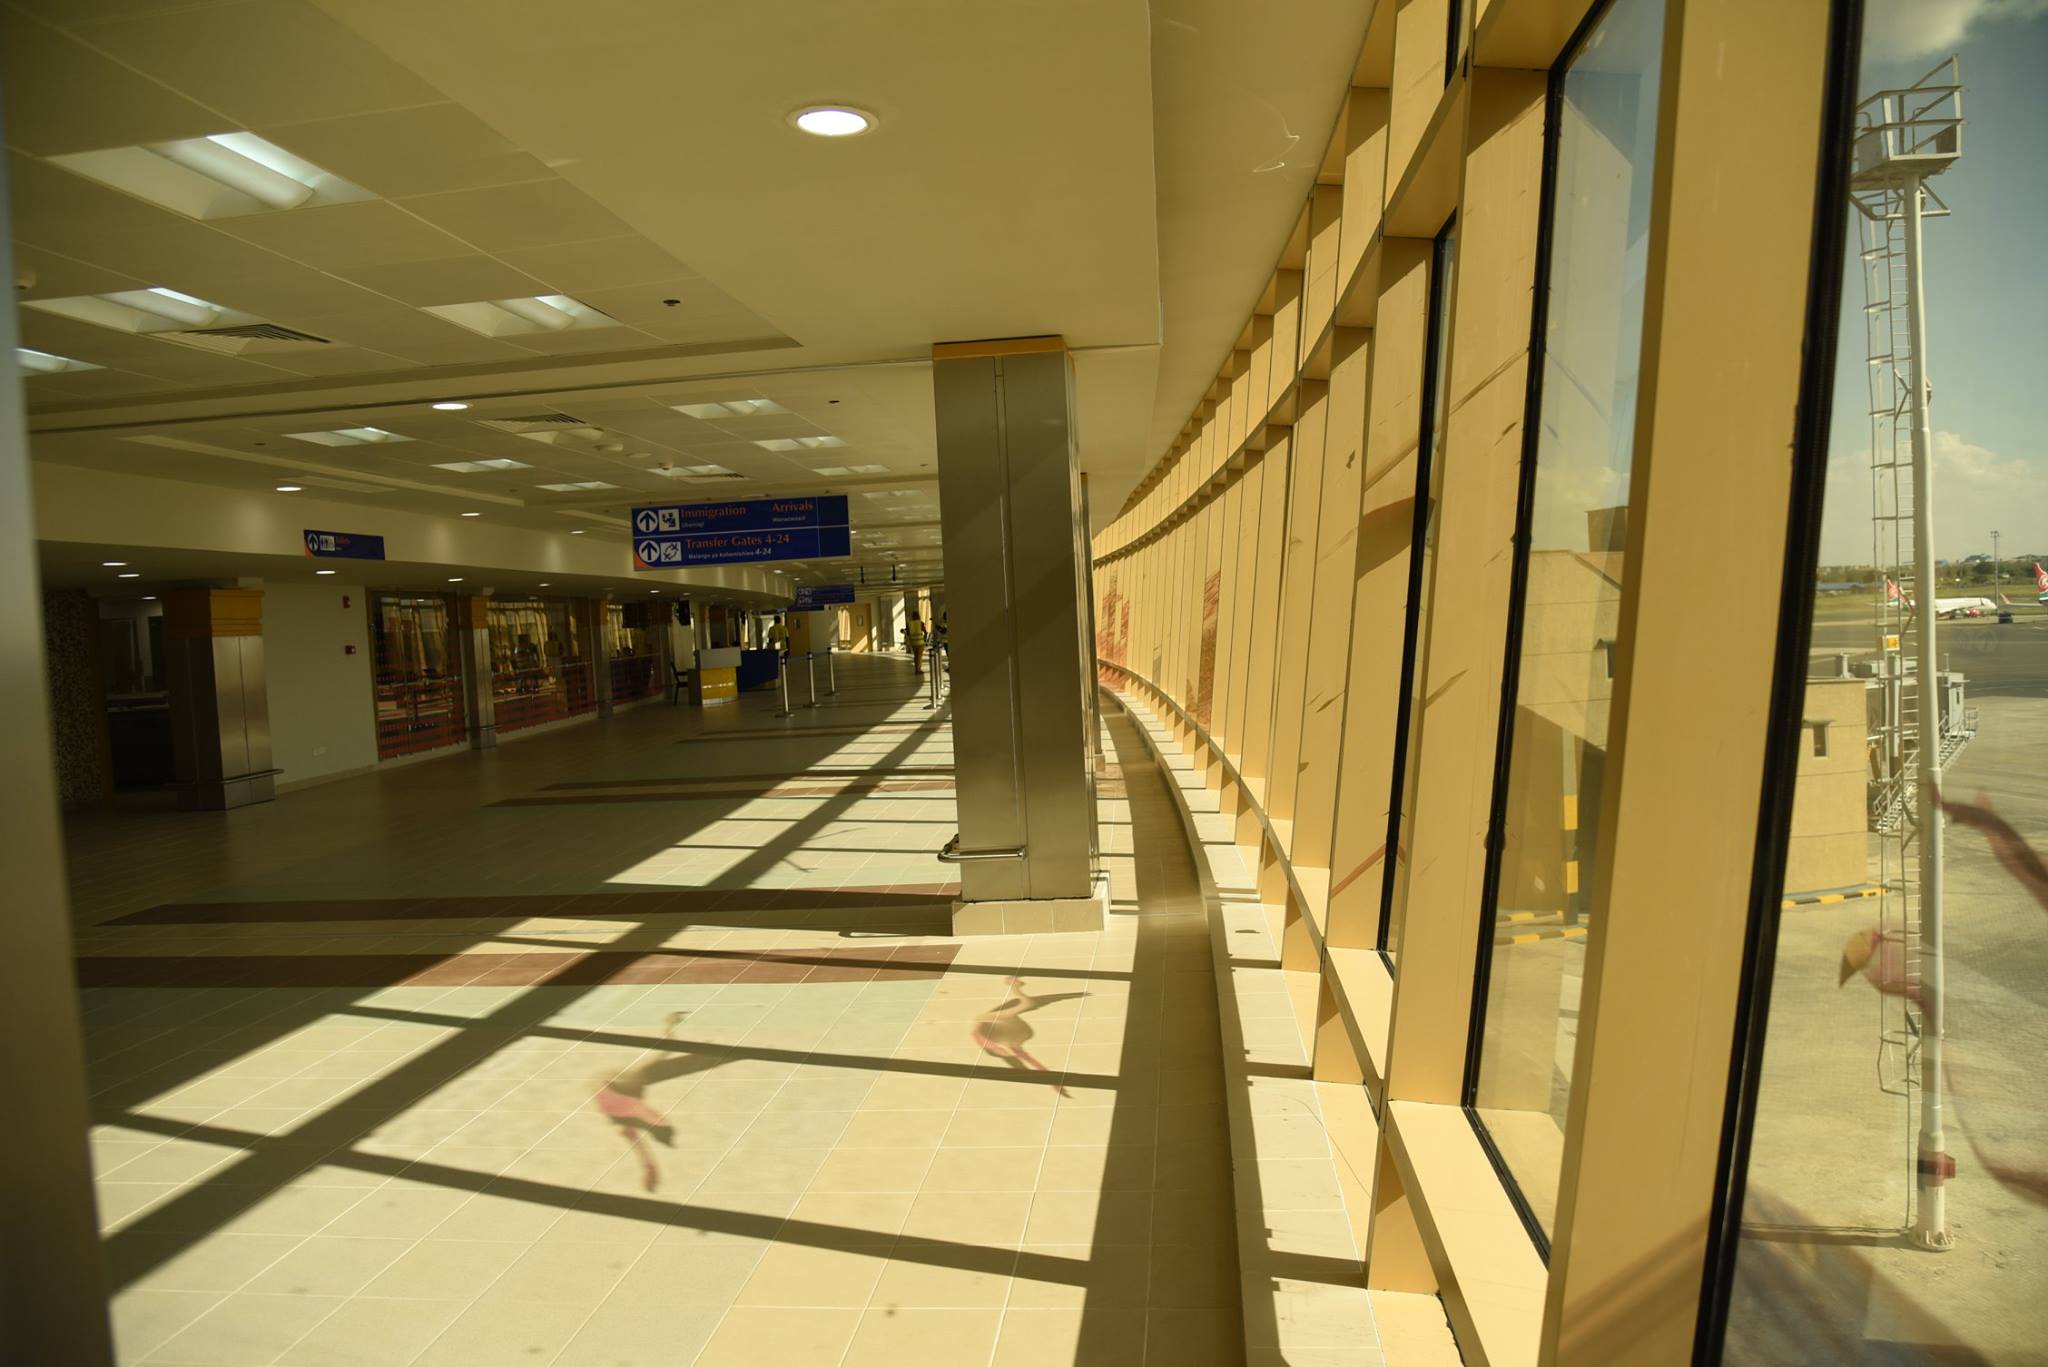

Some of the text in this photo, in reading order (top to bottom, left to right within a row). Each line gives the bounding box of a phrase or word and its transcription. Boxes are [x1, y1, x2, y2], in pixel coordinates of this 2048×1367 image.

[680, 505, 747, 520] Immigration
[772, 500, 814, 513] Arrivals
[687, 534, 790, 549] Transfer Gates 4-24
[755, 547, 772, 555] 4-24
